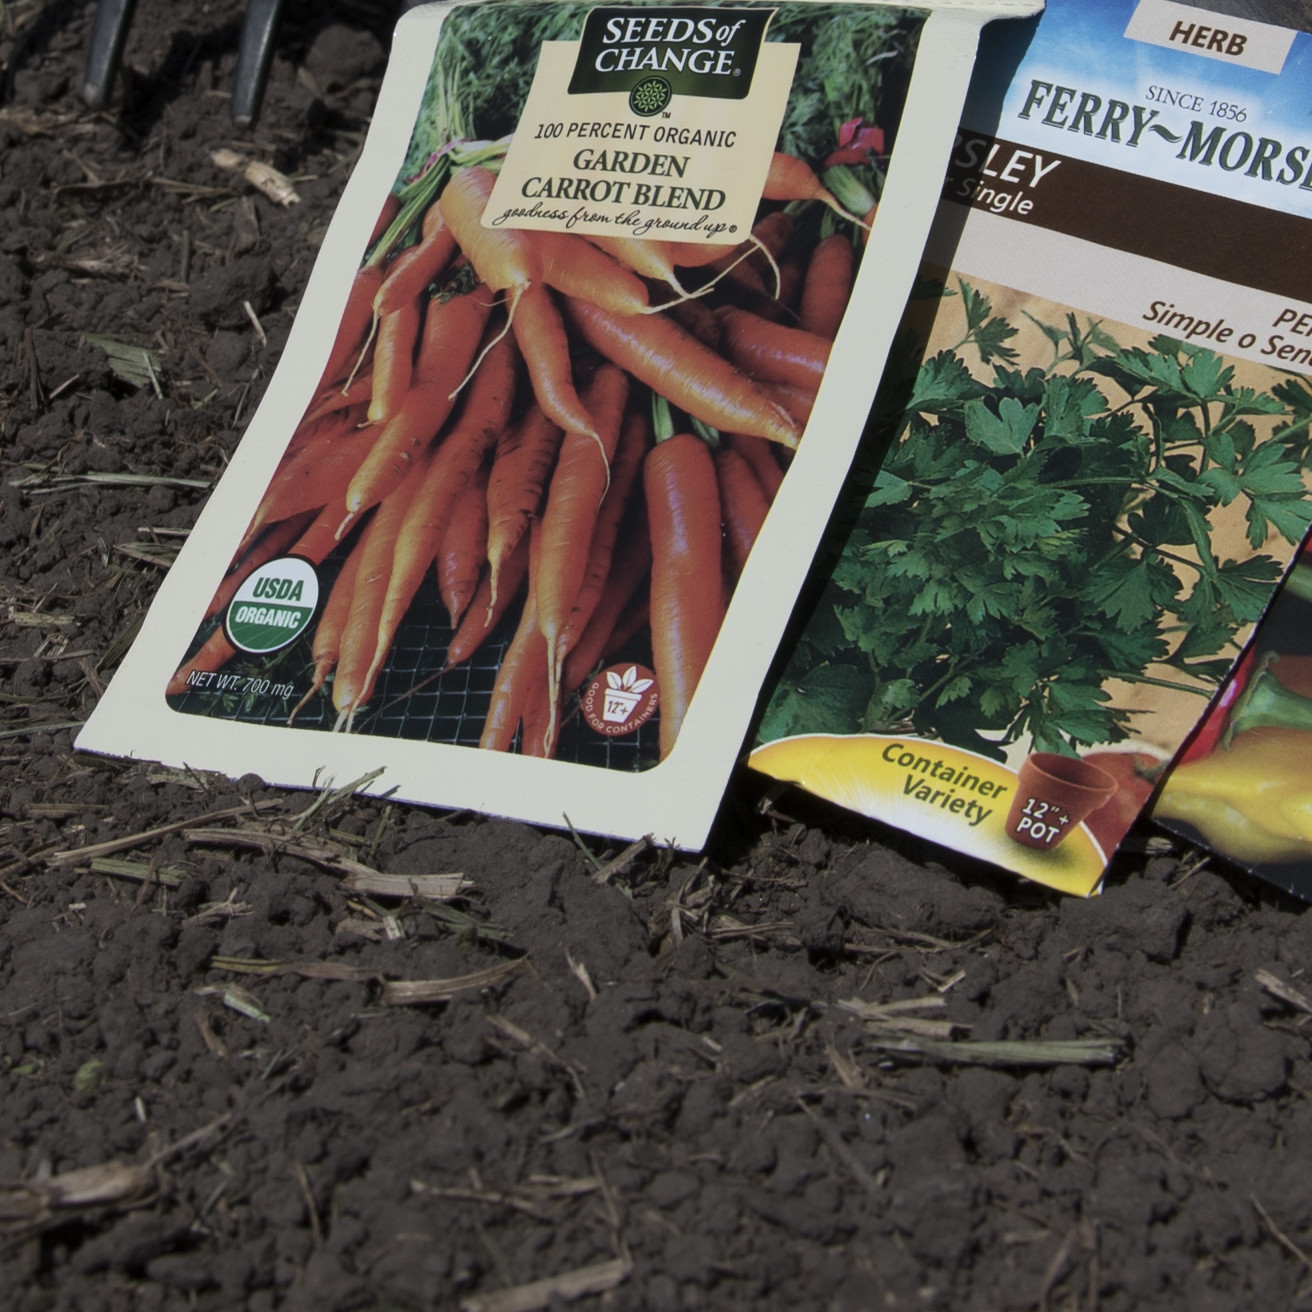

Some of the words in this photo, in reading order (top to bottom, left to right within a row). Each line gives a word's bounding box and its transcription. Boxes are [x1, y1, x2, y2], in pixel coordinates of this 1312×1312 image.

[602, 16, 717, 45] SEEDS
[715, 19, 747, 47] of
[1168, 19, 1249, 58] HERB
[1145, 84, 1205, 113] SINCE
[1207, 97, 1249, 123] 1856
[534, 123, 564, 140] 100
[566, 122, 651, 141] PERCENT
[653, 126, 737, 148] ORGANIC
[572, 148, 691, 179] GARDEN
[521, 176, 631, 204] CARROT
[631, 185, 726, 211] BLEND
[956, 177, 1035, 216] Single
[491, 202, 569, 226] goodness
[566, 206, 612, 229] from
[614, 209, 642, 227] the
[632, 214, 709, 235] ground
[1141, 299, 1235, 347] Simple
[1237, 332, 1255, 350] o
[252, 576, 305, 602] USDA
[234, 605, 302, 629] ORGANIC
[186, 670, 218, 688] NET
[217, 674, 241, 691] WT.
[242, 677, 270, 694] 700
[271, 683, 294, 700] mg
[585, 682, 600, 712] GOOD
[588, 713, 605, 730] FOR
[605, 693, 658, 734] CONTAINERS
[881, 742, 1009, 802] Container
[901, 774, 995, 828] Variety
[1015, 817, 1061, 847] POT
